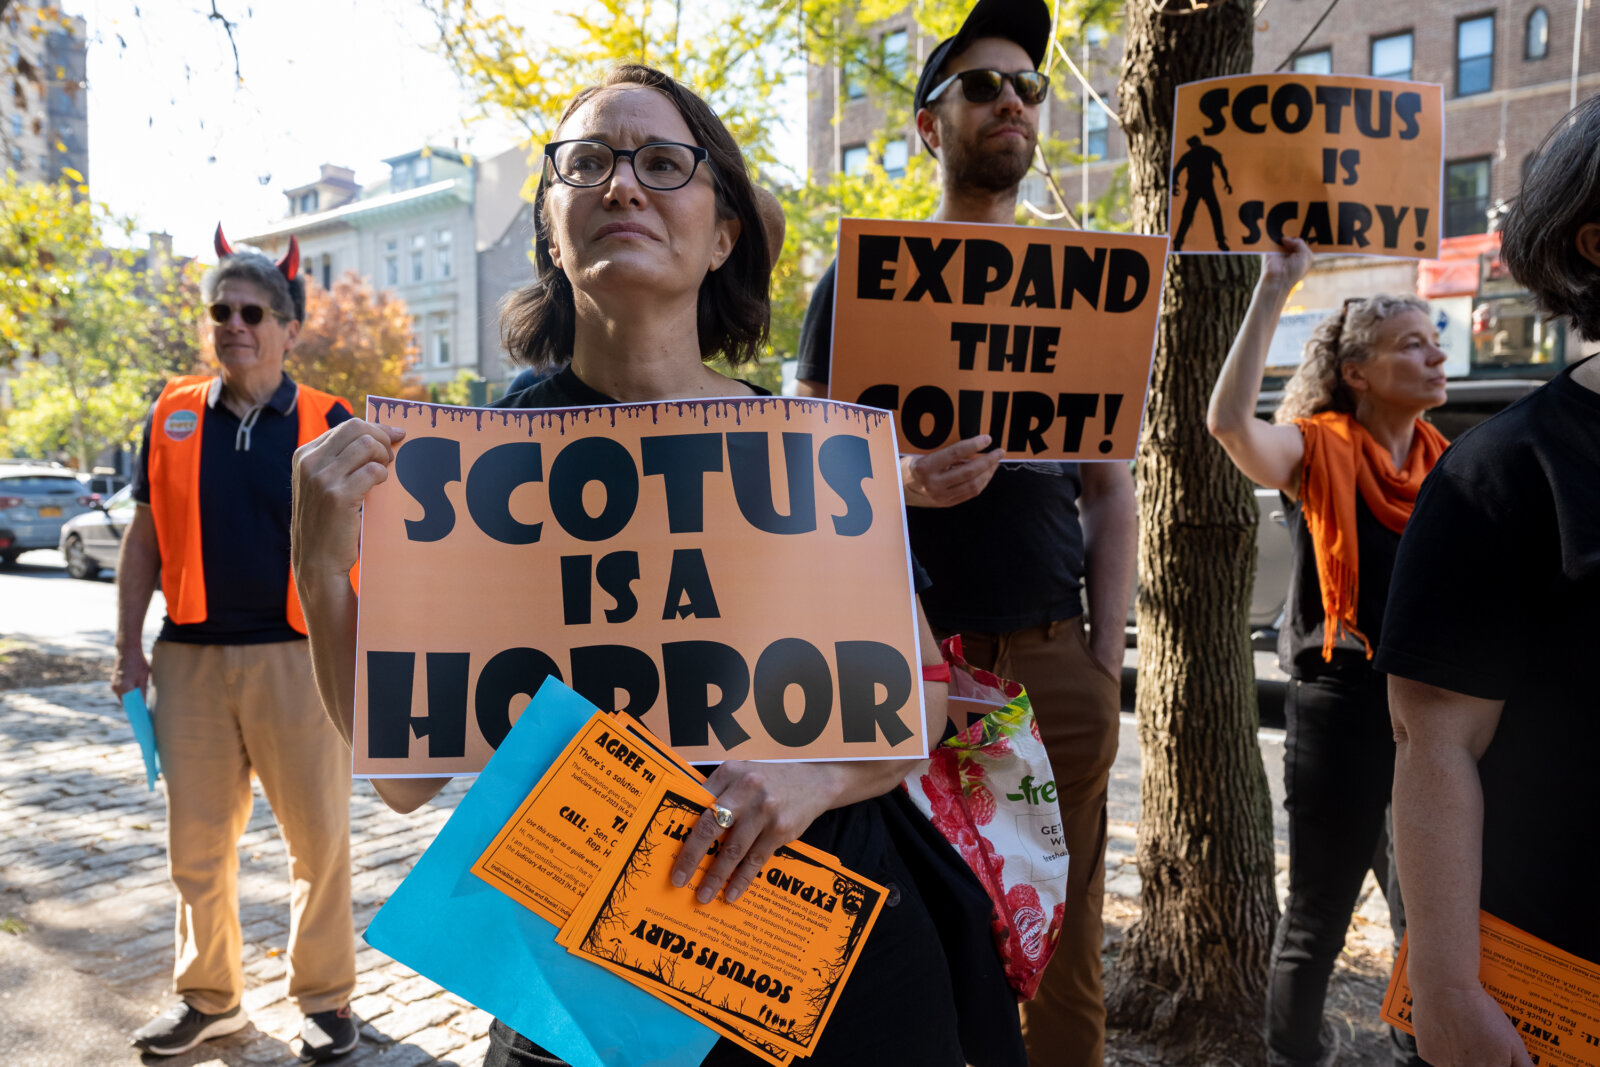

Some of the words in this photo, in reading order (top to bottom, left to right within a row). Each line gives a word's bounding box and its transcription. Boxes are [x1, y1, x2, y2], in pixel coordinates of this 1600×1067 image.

[1199, 83, 1422, 140] SCOTUS
[1322, 148, 1360, 186] IS
[1238, 200, 1430, 252] SCARY!
[857, 234, 1150, 314] EXPAND
[951, 322, 1061, 373] THE
[395, 431, 873, 545] SCOTUS
[560, 550, 640, 625] IS
[662, 548, 721, 620] A
[367, 637, 914, 758] HORROR
[594, 731, 645, 773] AGREE
[571, 772, 592, 790] Judiciary
[592, 787, 601, 796] Act
[606, 797, 619, 808] 2023
[579, 746, 605, 771] There's
[612, 774, 642, 797] solution:
[1018, 775, 1057, 805] fre
[620, 797, 637, 813] Congre
[526, 833, 535, 841] my
[534, 839, 550, 850] name
[559, 806, 589, 832] CALL:
[593, 827, 608, 843] Sen.
[522, 845, 535, 855] your
[526, 818, 537, 827] Use
[536, 825, 546, 834] this
[546, 832, 561, 844] script
[570, 849, 585, 860] guide
[585, 858, 599, 869] when
[585, 837, 601, 853] Rep.
[514, 850, 537, 868] Judiciary
[536, 864, 547, 873] Act
[552, 874, 566, 885] 2023
[766, 868, 838, 913] EXPAND
[629, 919, 697, 959] SCARY
[695, 947, 719, 970] IS
[716, 957, 793, 1004] SCOTUS
[1488, 985, 1518, 1002] Jeffries
[1519, 999, 1555, 1019] Hakeem
[1526, 1011, 1552, 1027] Chuck
[1557, 1014, 1577, 1028] Rep.
[1521, 1021, 1560, 1046] TAKE
[1555, 1023, 1573, 1036] Sen.
